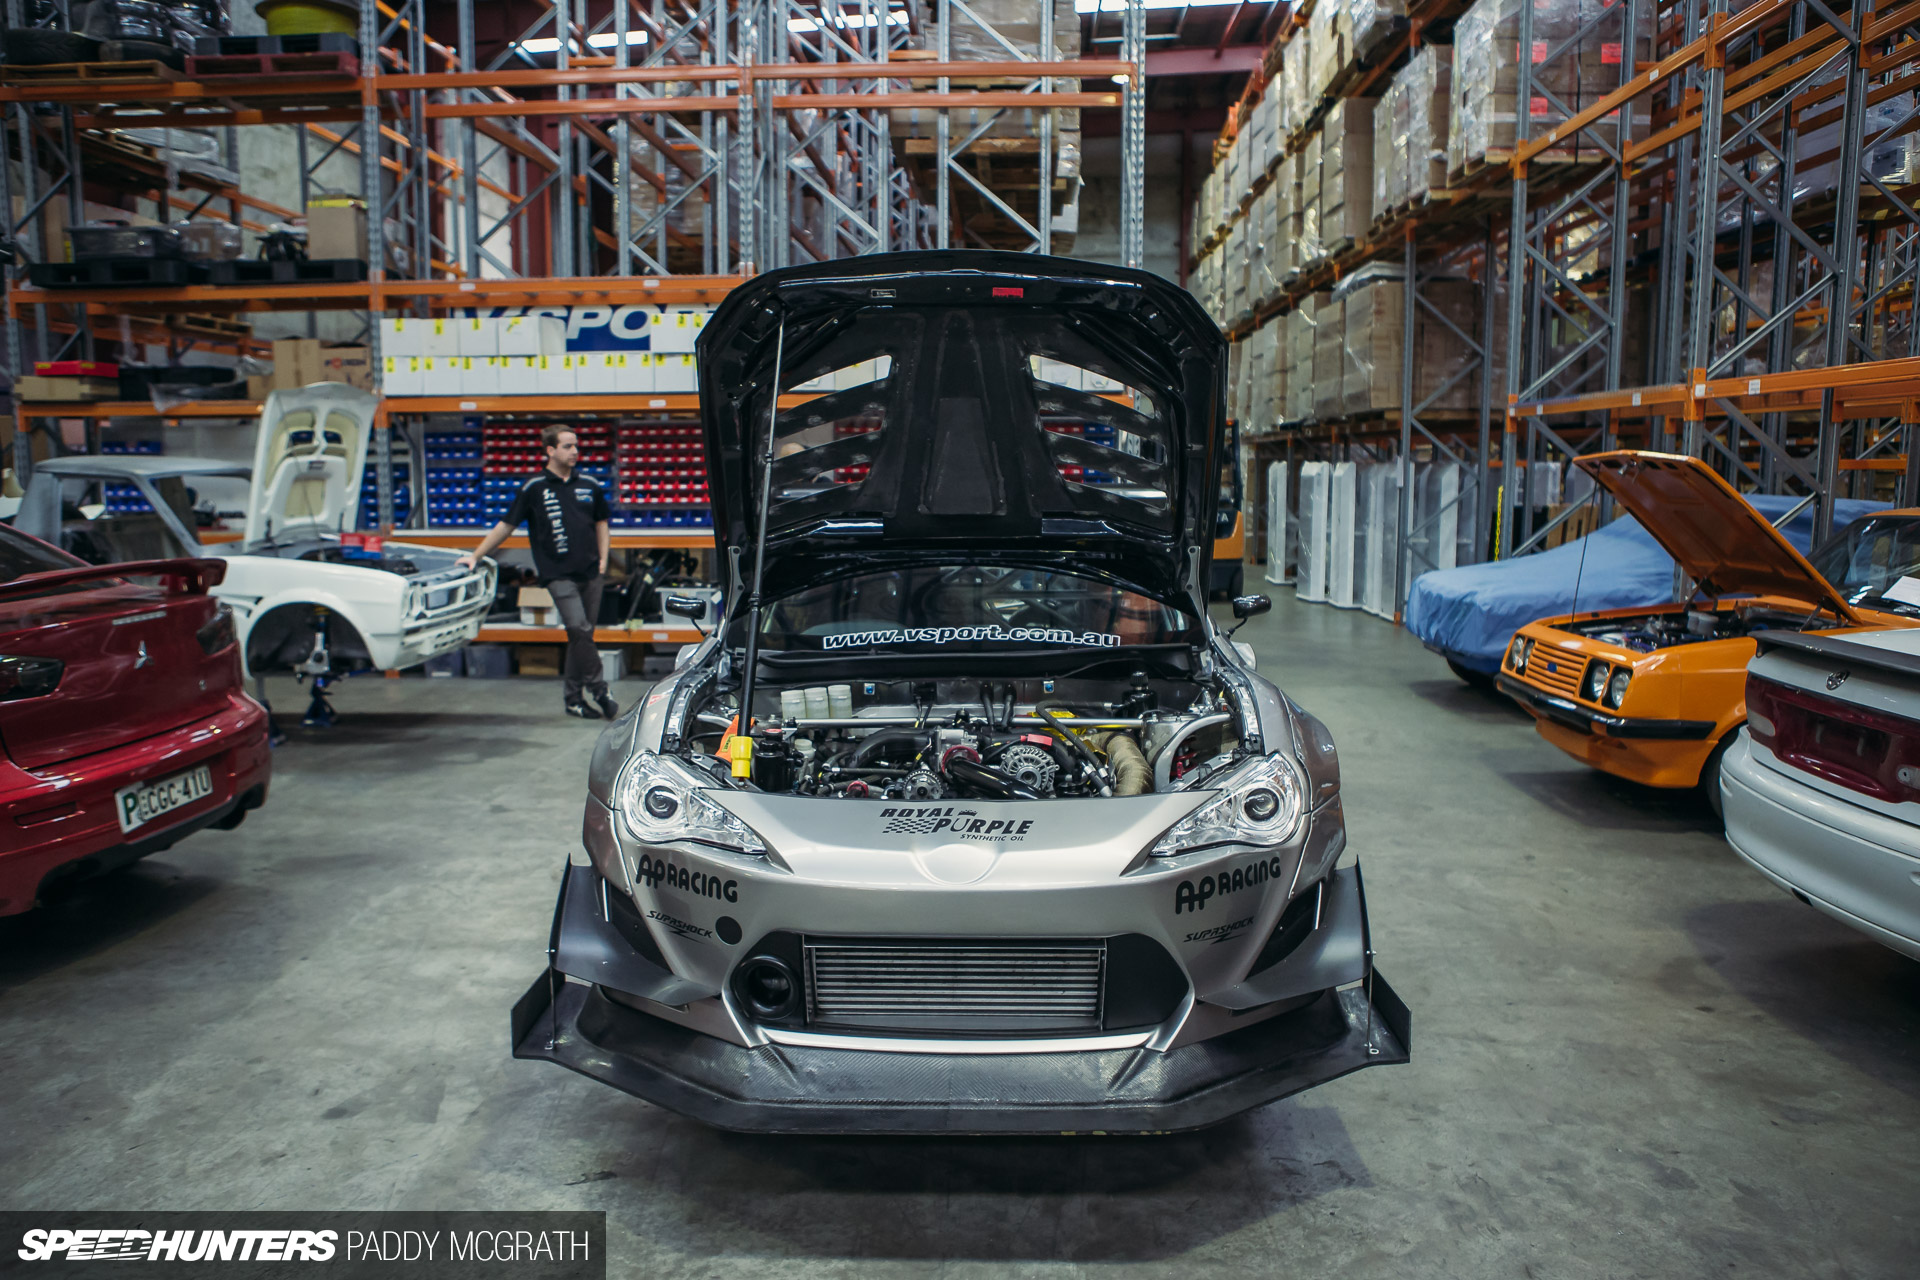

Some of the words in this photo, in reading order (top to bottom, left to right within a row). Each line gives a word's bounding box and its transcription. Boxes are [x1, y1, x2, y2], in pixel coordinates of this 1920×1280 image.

[823, 624, 1121, 649] www.vsport.com.au
[122, 792, 140, 826] P
[879, 807, 955, 818] ROYAL
[930, 818, 1035, 835] PURPLE
[960, 833, 1007, 842] SYNTHETIC
[635, 854, 666, 890] AP
[667, 862, 738, 903] RACING
[1175, 875, 1216, 915] AP
[1217, 856, 1282, 896] RACING
[646, 910, 714, 939] SUPASHOCK
[1183, 916, 1255, 943] SUPASHOCK
